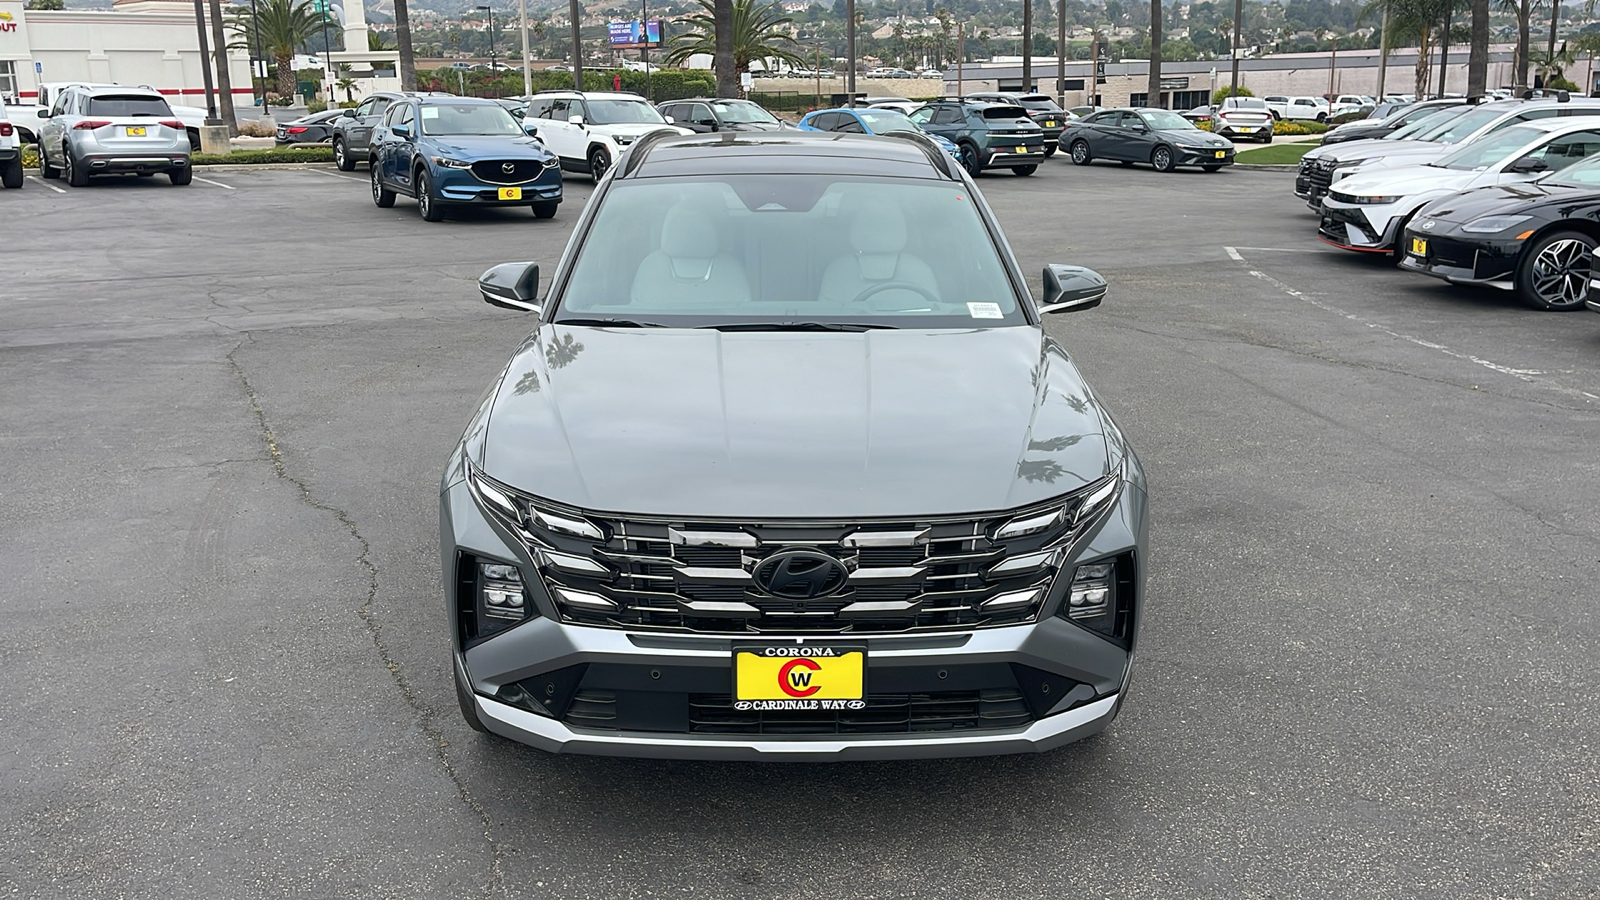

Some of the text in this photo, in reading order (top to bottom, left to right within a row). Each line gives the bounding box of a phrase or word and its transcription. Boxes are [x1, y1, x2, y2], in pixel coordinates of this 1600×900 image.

[0, 23, 17, 32] UT
[765, 647, 835, 657] CORONA
[752, 700, 847, 710] CARDINALE WAY
